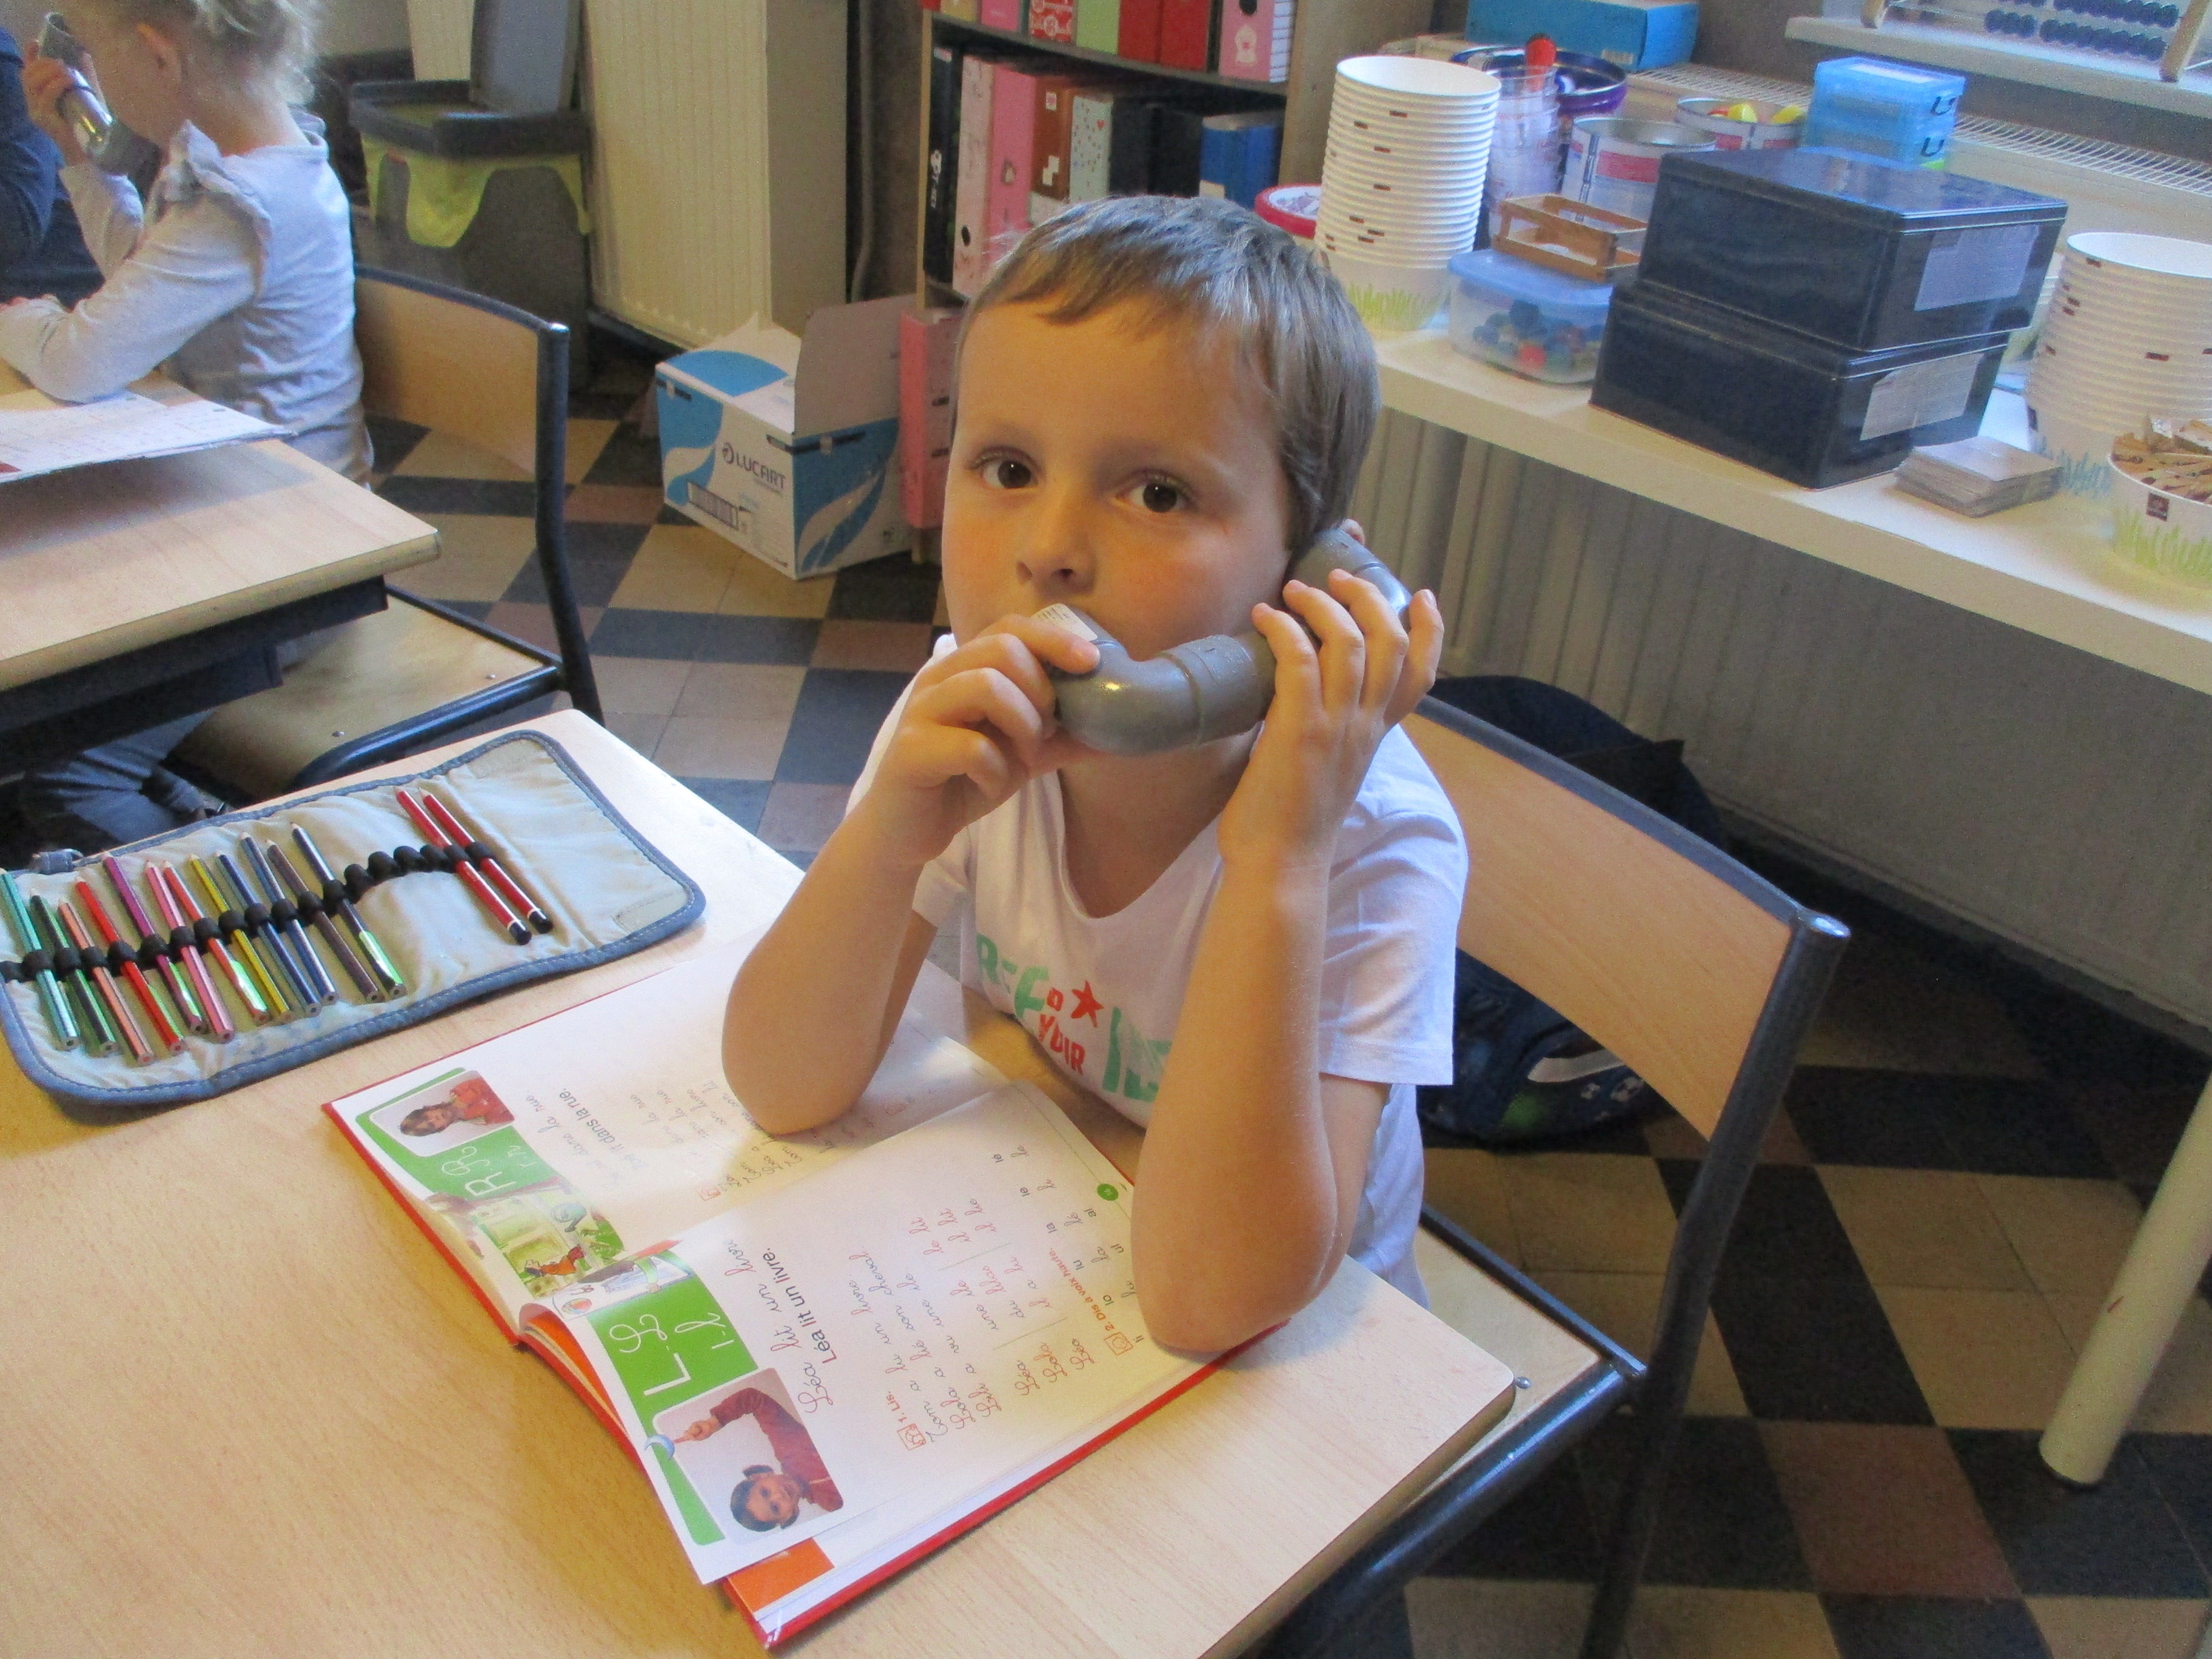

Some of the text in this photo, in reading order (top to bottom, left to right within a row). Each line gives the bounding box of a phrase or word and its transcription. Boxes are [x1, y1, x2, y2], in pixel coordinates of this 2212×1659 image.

[736, 453, 786, 489] LUCART
[559, 1088, 580, 1107] rue.
[575, 1107, 591, 1119] la
[538, 1116, 562, 1132] la
[586, 1118, 615, 1142] dans
[992, 1153, 1004, 1162] lé
[1020, 1186, 1030, 1196] le
[909, 1216, 931, 1234] lit
[1046, 1222, 1057, 1233] la
[1064, 1211, 1084, 1225] lé
[1084, 1207, 1124, 1253] ul al
[923, 1239, 944, 1255] le
[1091, 1245, 1111, 1262] la
[1047, 1247, 1071, 1276] haute.
[1073, 1259, 1085, 1270] lu
[965, 1198, 1095, 1369] Léo il a lu il lie
[1070, 1276, 1086, 1295] voix
[758, 1283, 782, 1312] un
[761, 1247, 837, 1363] Léa lit un livre.
[937, 1208, 1068, 1382] Lola du lilas il lit
[1103, 1294, 1114, 1305] lo
[896, 1305, 916, 1330] son
[922, 1299, 943, 1326] une
[976, 1303, 999, 1330] une
[1091, 1303, 1107, 1320] Dis
[874, 1322, 892, 1344] un
[1105, 1321, 1115, 1330] 2.
[770, 1324, 802, 1351] lit
[947, 1335, 959, 1353] vu
[910, 1339, 933, 1360] lié
[885, 1353, 908, 1373] lu
[934, 1366, 946, 1377] a
[965, 1362, 976, 1373] a
[797, 1361, 833, 1413] Léa
[910, 1379, 921, 1391] a
[1014, 1359, 1040, 1395] Léa
[885, 1390, 900, 1410] Lis.
[940, 1387, 976, 1429] Lola
[968, 1382, 1002, 1416] Lili
[923, 1400, 948, 1442] Tom
